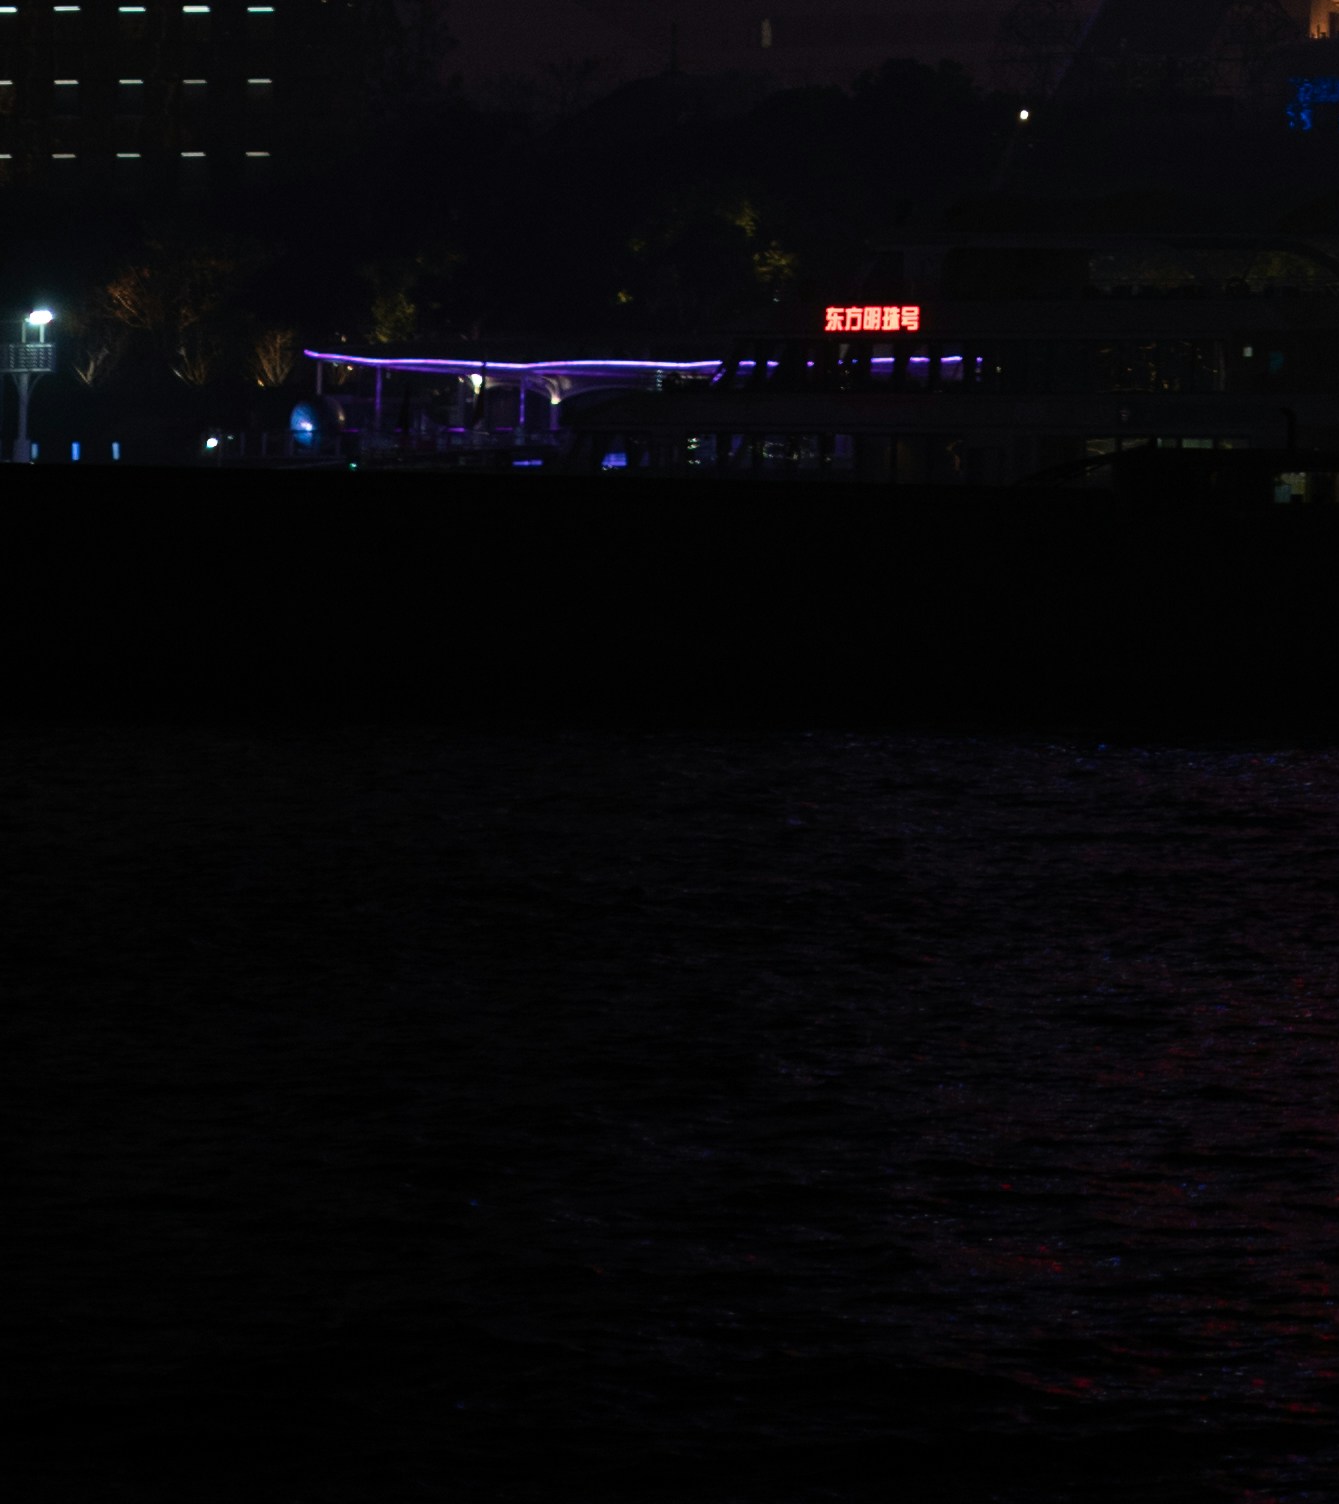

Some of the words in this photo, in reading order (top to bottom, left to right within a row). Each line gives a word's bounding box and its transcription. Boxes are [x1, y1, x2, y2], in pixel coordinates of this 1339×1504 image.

[824, 306, 920, 332] 东方明珠号
